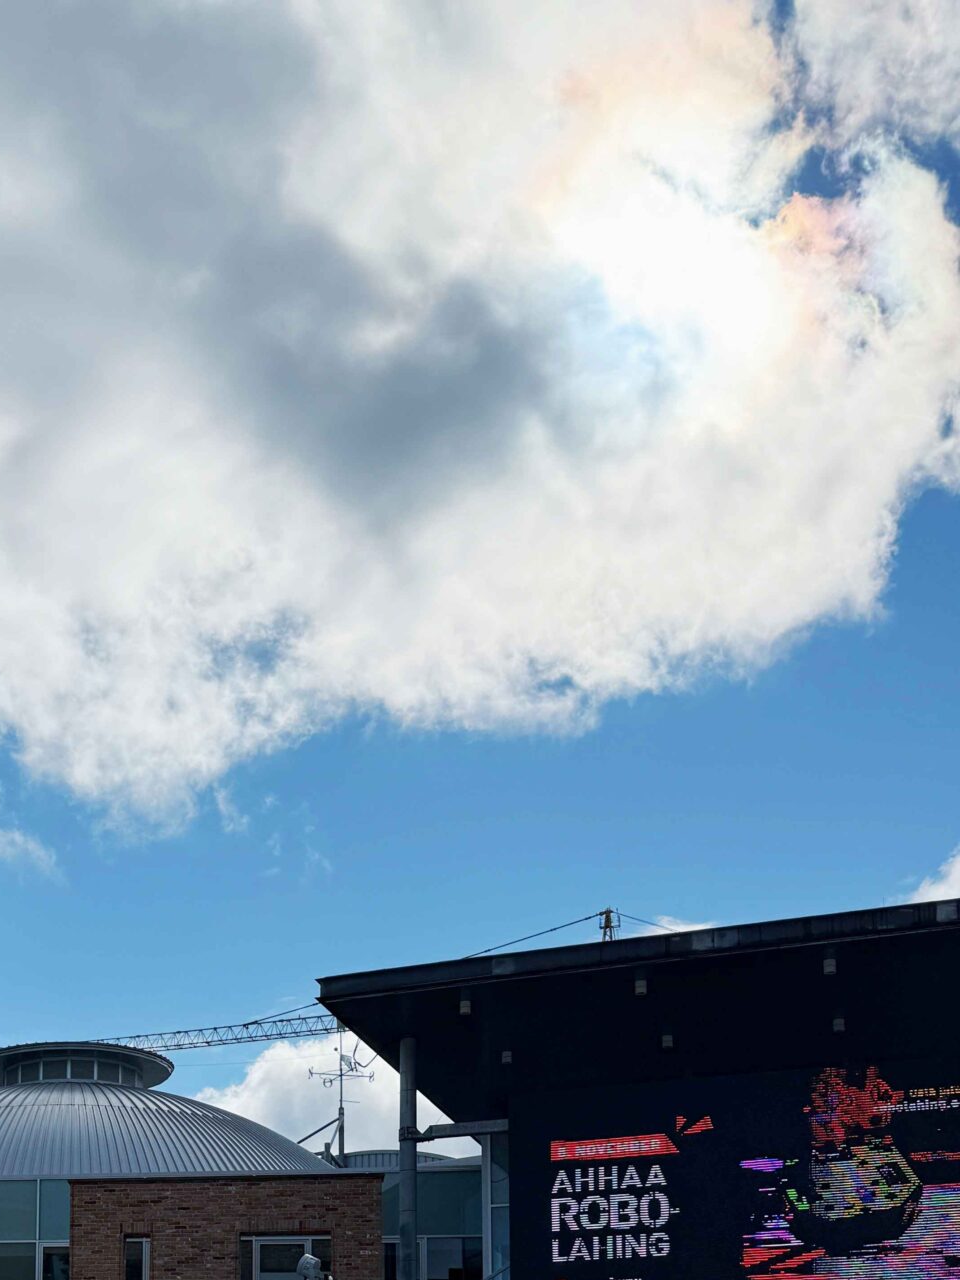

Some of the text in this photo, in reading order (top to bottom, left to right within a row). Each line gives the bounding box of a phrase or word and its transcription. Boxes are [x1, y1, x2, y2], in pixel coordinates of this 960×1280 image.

[575, 1139, 662, 1156] NOVEMBER
[551, 1164, 668, 1194] AHHAA
[550, 1191, 681, 1232] ROBO-
[551, 1232, 671, 1263] LAHING
